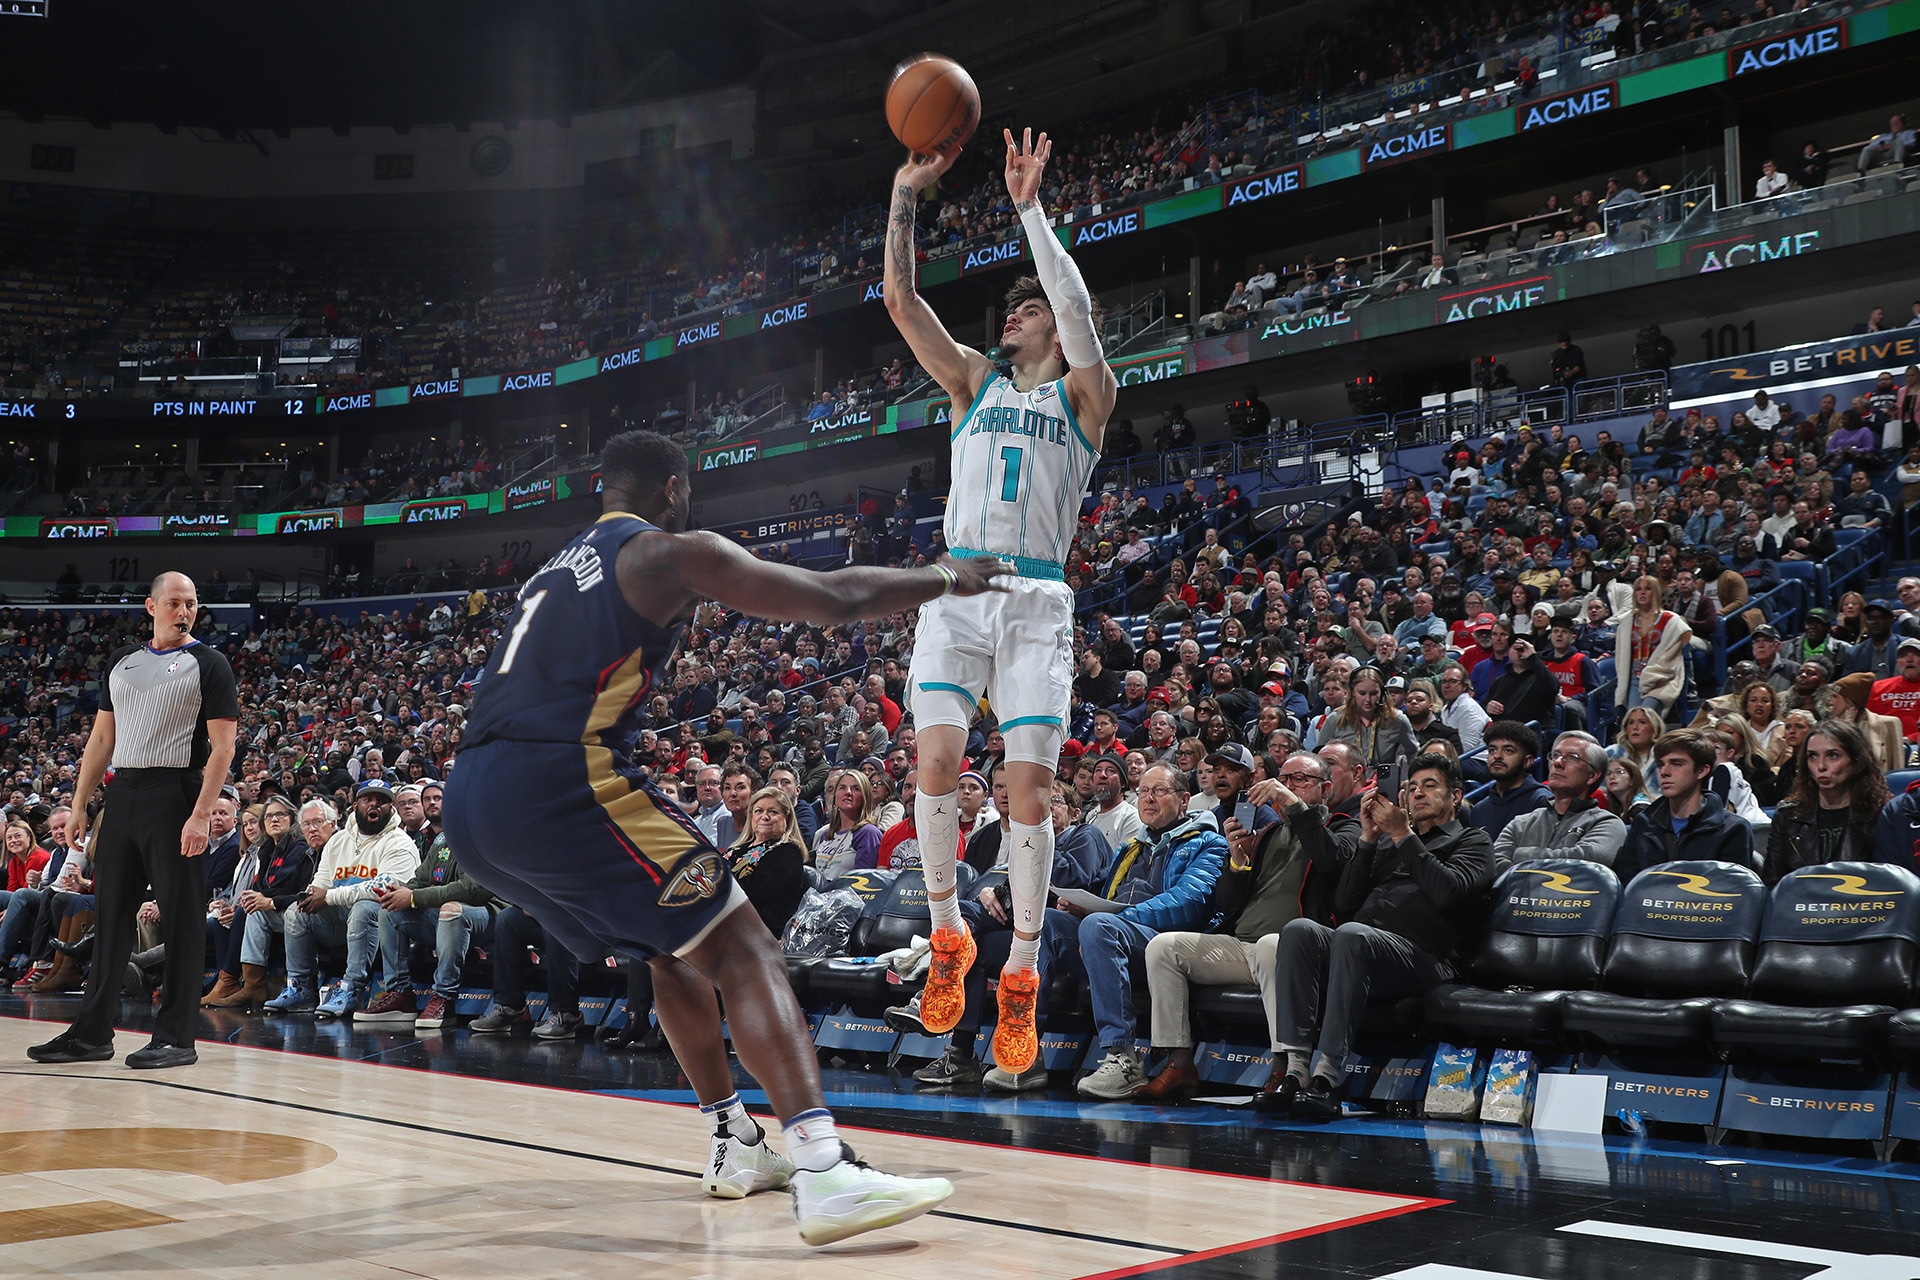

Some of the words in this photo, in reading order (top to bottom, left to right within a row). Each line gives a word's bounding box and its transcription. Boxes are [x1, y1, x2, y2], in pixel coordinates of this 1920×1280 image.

[1736, 26, 1840, 76] ACME
[1522, 87, 1611, 129] ACME
[1366, 126, 1446, 164] ACME
[1228, 170, 1299, 206] ACME
[1075, 213, 1138, 245] ACME
[964, 240, 1021, 270] ACME
[863, 281, 883, 302] AC
[761, 302, 808, 329] ACME
[677, 322, 721, 347] ACME
[1702, 320, 1756, 360] 101
[601, 348, 641, 372] ACME
[503, 372, 552, 391] ACME
[1115, 359, 1182, 388] CME
[413, 379, 459, 397] ACME
[65, 403, 76, 419] 3
[153, 402, 185, 416] PTS
[188, 401, 205, 416] IN
[209, 400, 257, 415] PAINT
[284, 400, 304, 415] 12
[326, 394, 371, 412] ACME
[970, 407, 1066, 447] CHARLOTTE
[1001, 446, 1023, 502] 1
[758, 513, 845, 538] BETRIVERS
[110, 557, 139, 582] 121
[497, 589, 548, 674] 1
[1509, 896, 1591, 907] BETRIVERS
[1642, 898, 1733, 911] BETRIVERS
[1794, 901, 1896, 912] BETRIVERS
[1512, 909, 1582, 919] SPORTSBOOK
[1647, 912, 1723, 923] SPORTSBOOK
[1801, 915, 1886, 924] SPORTSBOOK
[845, 1023, 895, 1033] BETRIVERS
[1040, 1041, 1079, 1049] RIVERS
[1227, 1053, 1273, 1065] BETRIV
[1345, 1064, 1423, 1077] BETRIVERS
[1614, 1082, 1710, 1099] BETRIVERS
[1770, 1097, 1875, 1113] BETRIVERS
